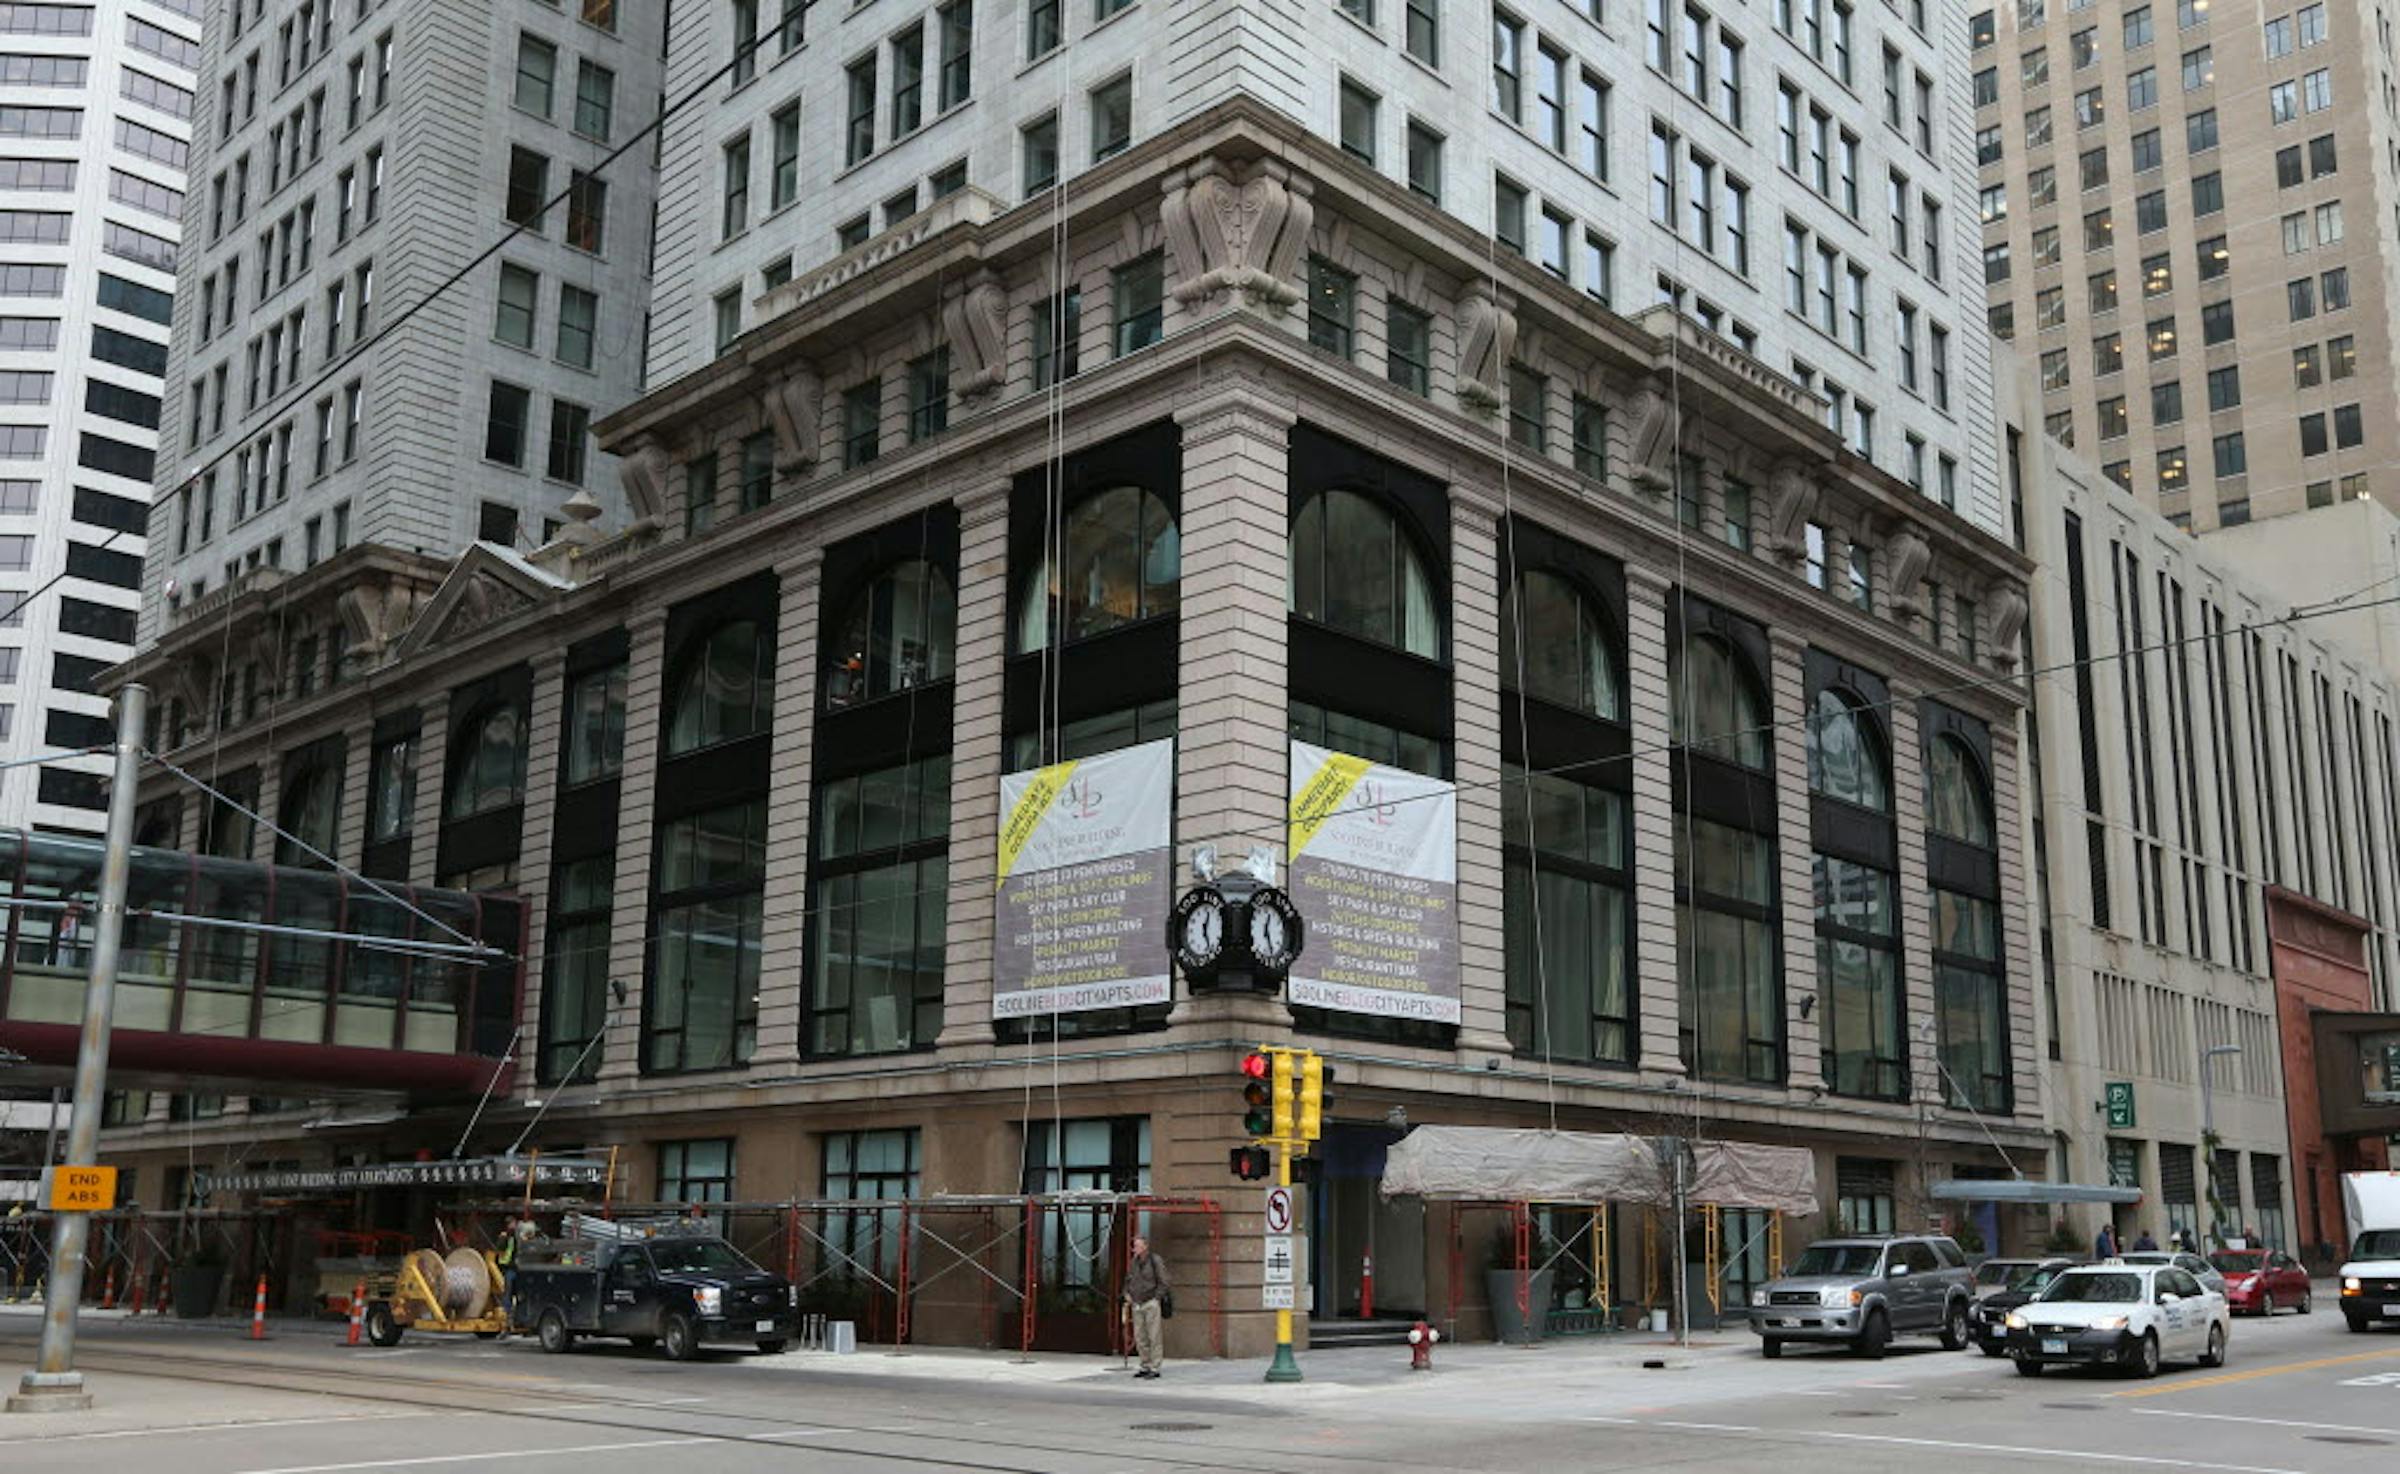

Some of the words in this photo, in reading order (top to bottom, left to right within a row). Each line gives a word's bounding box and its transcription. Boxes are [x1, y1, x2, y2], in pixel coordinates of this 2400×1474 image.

[1296, 763, 1339, 818] IMMEDIATE
[1303, 777, 1348, 832] OCCUPANCY
[68, 1190, 100, 1202] ABS
[70, 1173, 100, 1186] END
